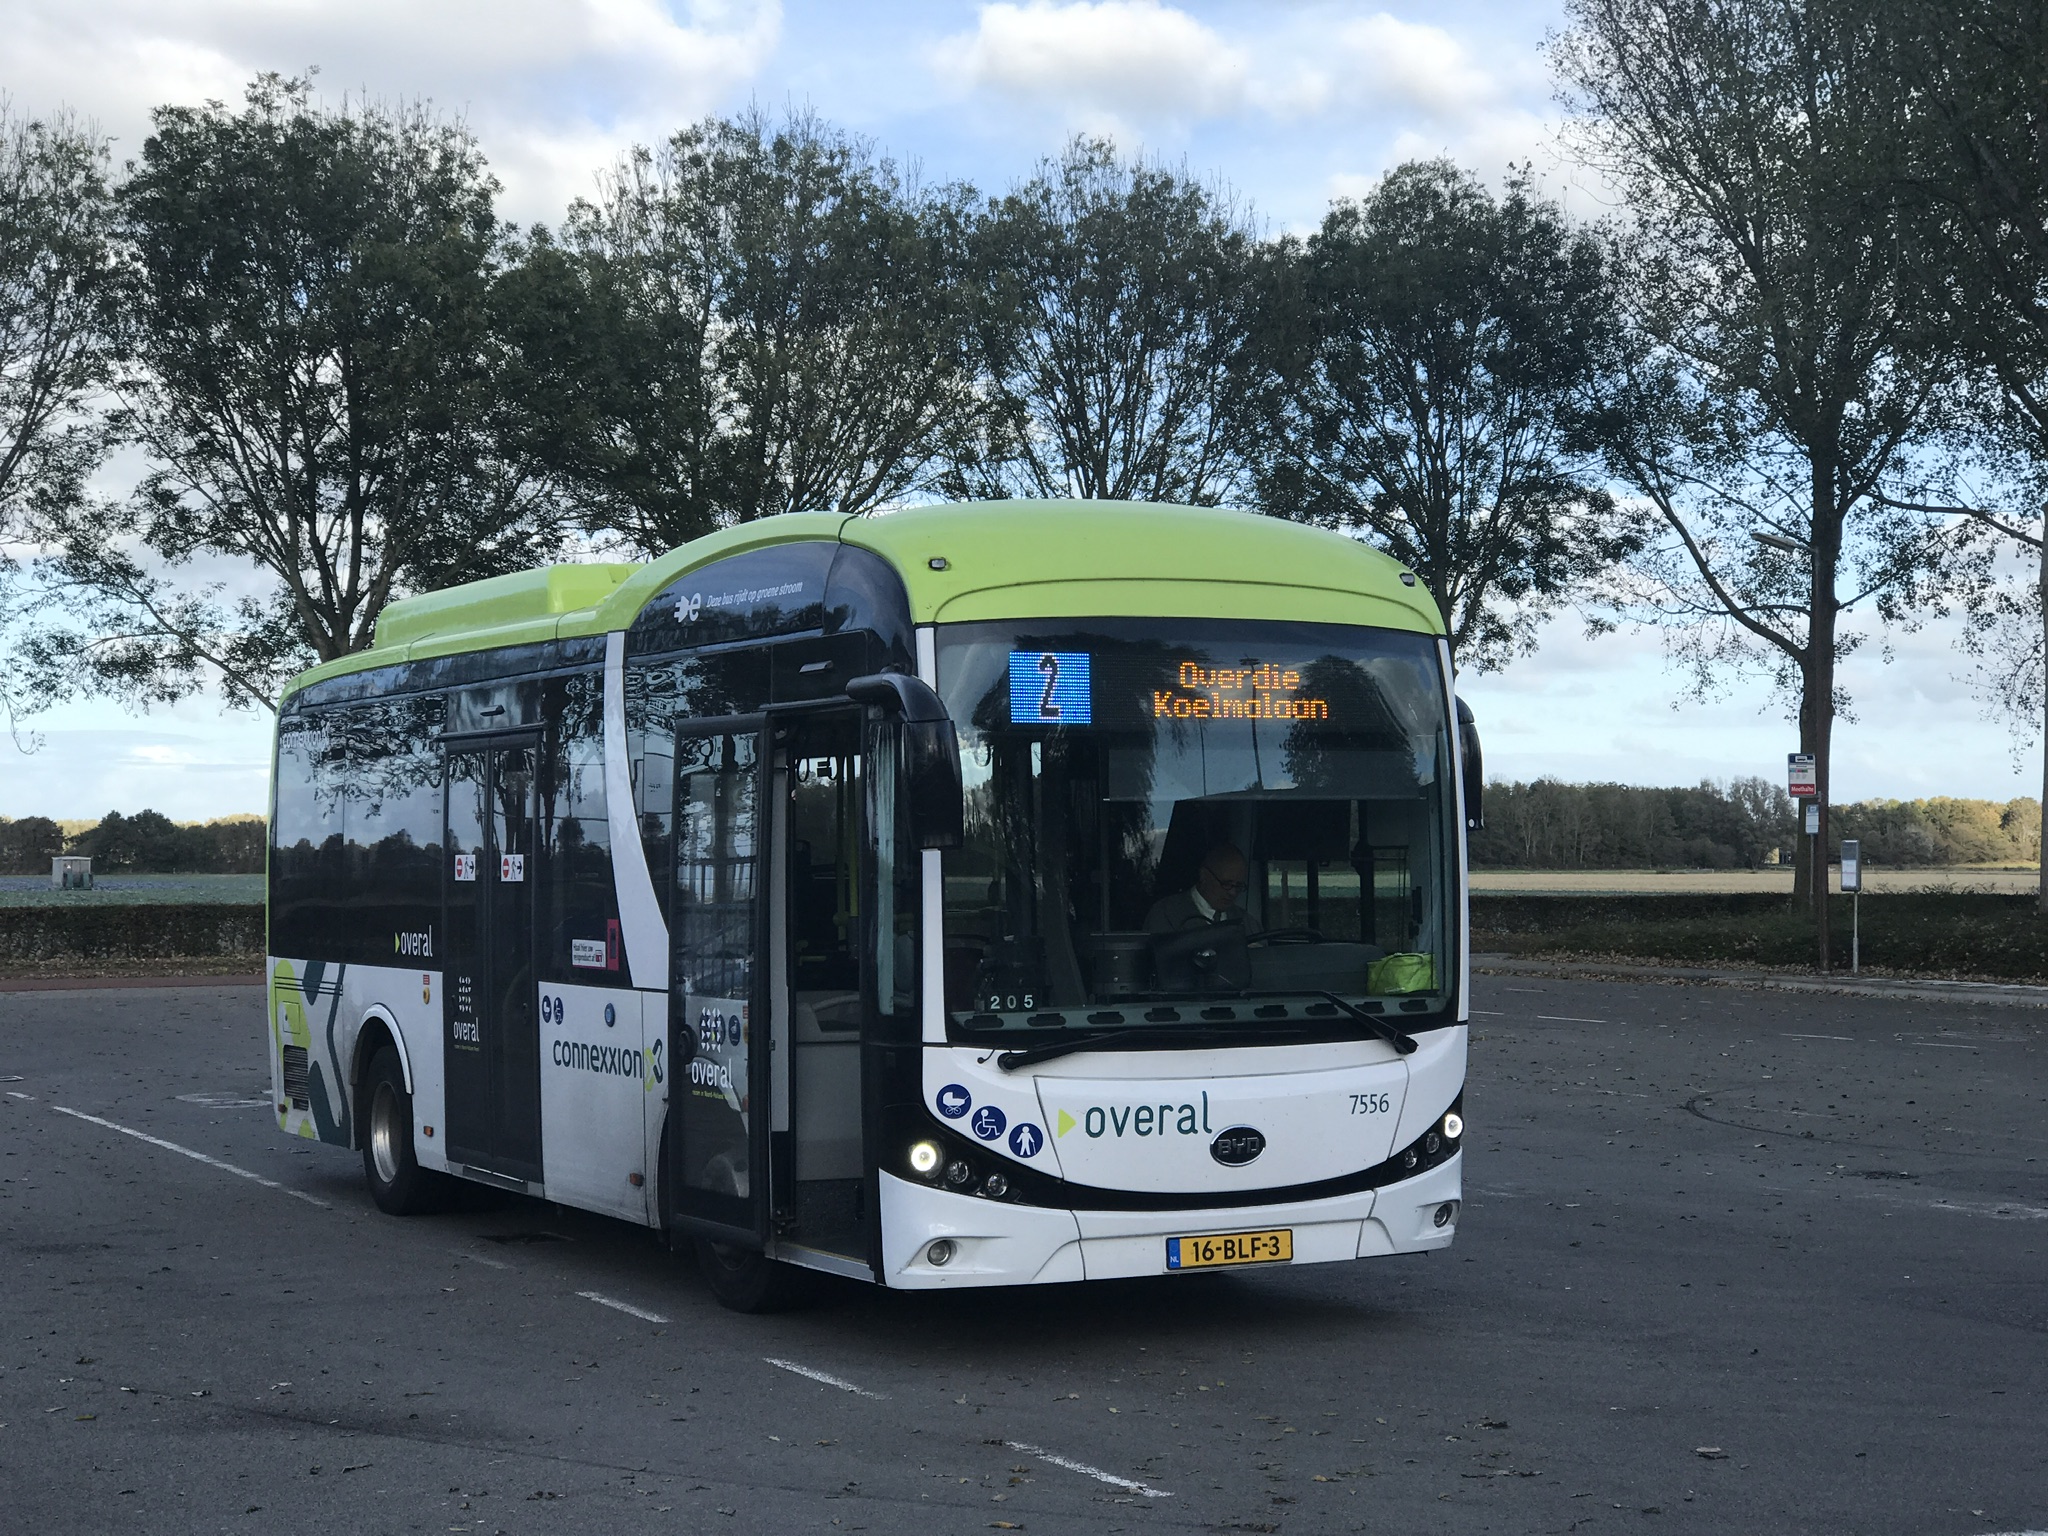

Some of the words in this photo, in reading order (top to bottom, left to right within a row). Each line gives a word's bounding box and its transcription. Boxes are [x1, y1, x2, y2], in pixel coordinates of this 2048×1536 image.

[706, 595, 721, 608] Deze
[722, 592, 734, 606] bus
[734, 588, 749, 606] rijdt
[748, 590, 757, 603] op
[756, 586, 779, 602] groene
[779, 581, 803, 596] stroom
[1037, 652, 1062, 720] 2
[1179, 661, 1301, 690] Overdie
[1153, 691, 1329, 720] Koelmalaan
[400, 924, 433, 957] overal
[453, 1016, 480, 1043] overal
[553, 1038, 643, 1079] connexxion
[691, 1058, 733, 1089] overal
[1085, 1090, 1213, 1138] overal
[1349, 1092, 1389, 1115] 7556
[1217, 1136, 1260, 1156] BYD
[1169, 1255, 1179, 1263] NL
[1192, 1235, 1280, 1262] 16-BLF-3
